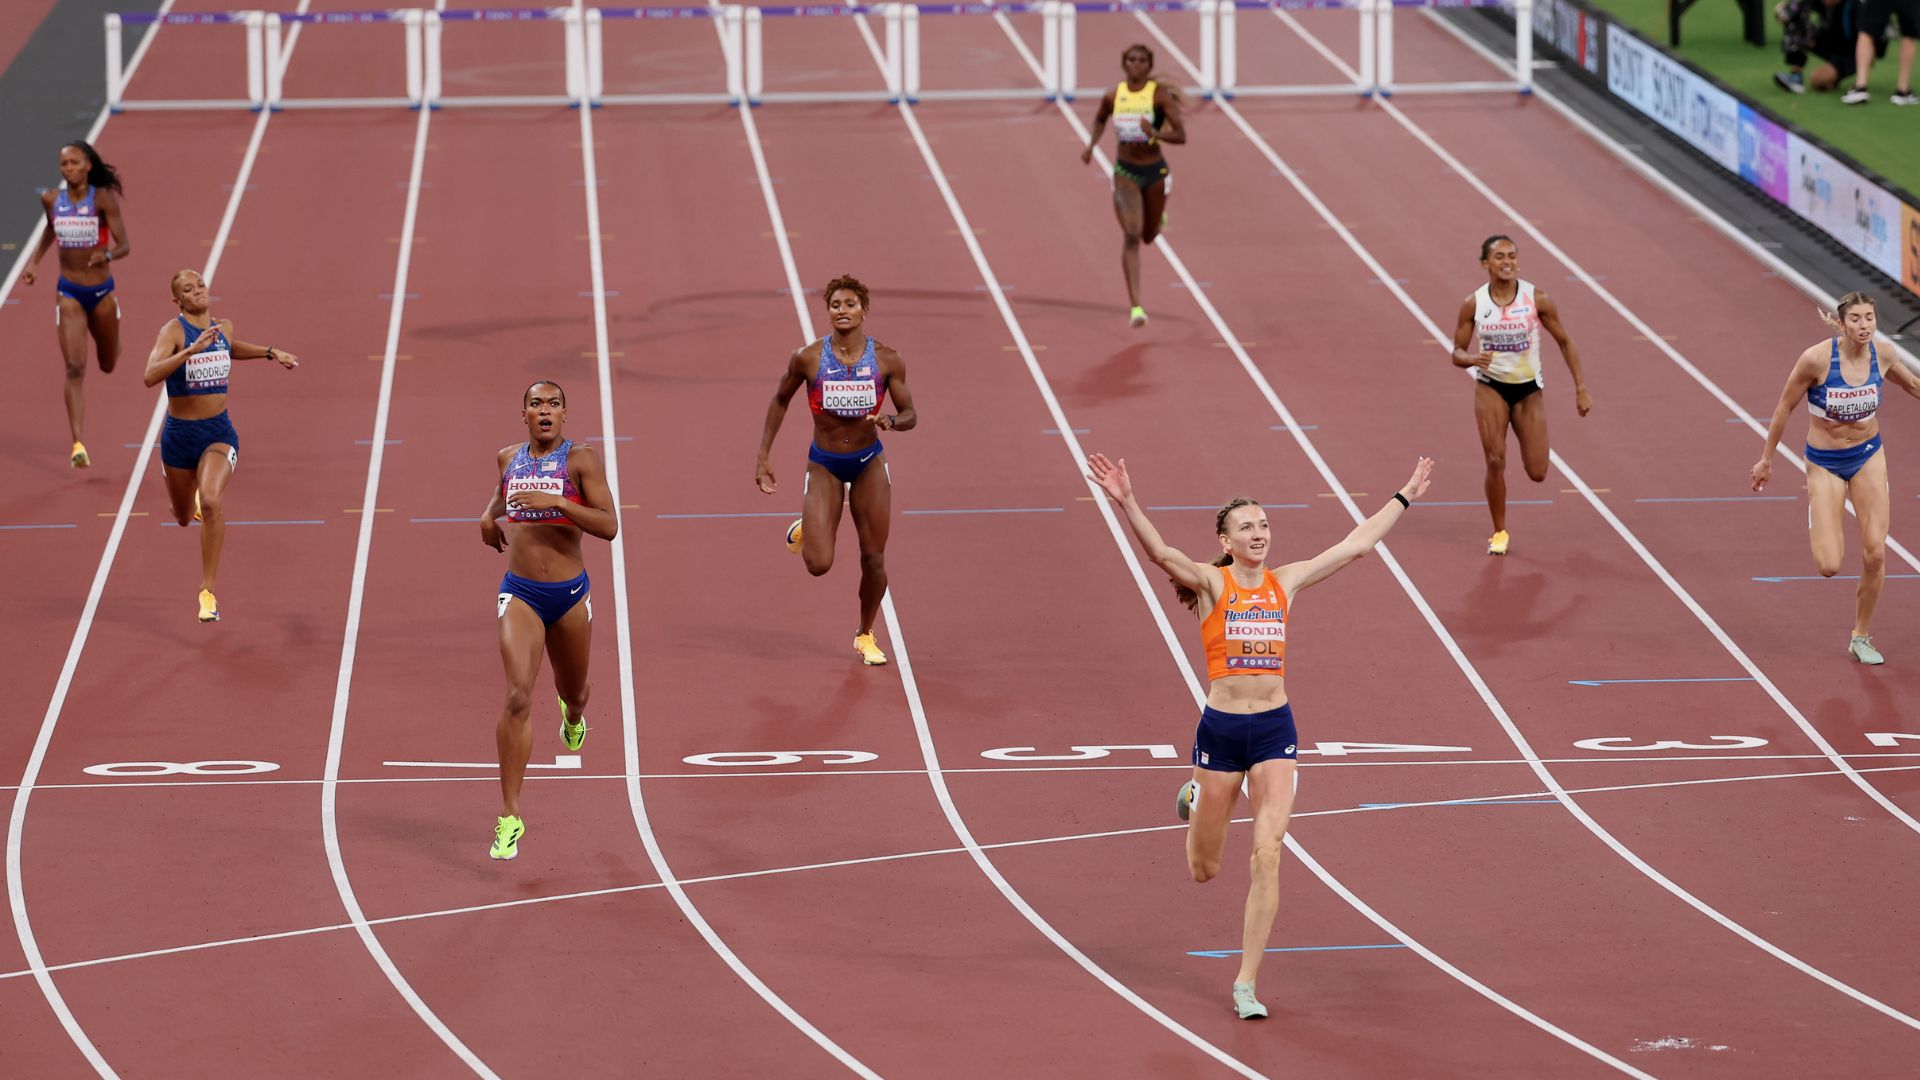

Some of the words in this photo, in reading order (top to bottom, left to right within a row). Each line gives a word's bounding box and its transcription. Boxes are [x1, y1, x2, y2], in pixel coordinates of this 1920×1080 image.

[188, 354, 228, 365] HONDA
[199, 379, 225, 388] TOKYO
[1828, 388, 1876, 399] HONDA
[826, 395, 875, 407] COCKRELL
[509, 482, 561, 491] HONDA
[1224, 607, 1283, 622] Nederland
[1227, 626, 1283, 637] HONDA
[1242, 641, 1277, 655] BOL
[1573, 735, 1769, 751] 3
[683, 750, 880, 767] 6
[981, 744, 1179, 761] 5
[83, 760, 281, 777] 8
